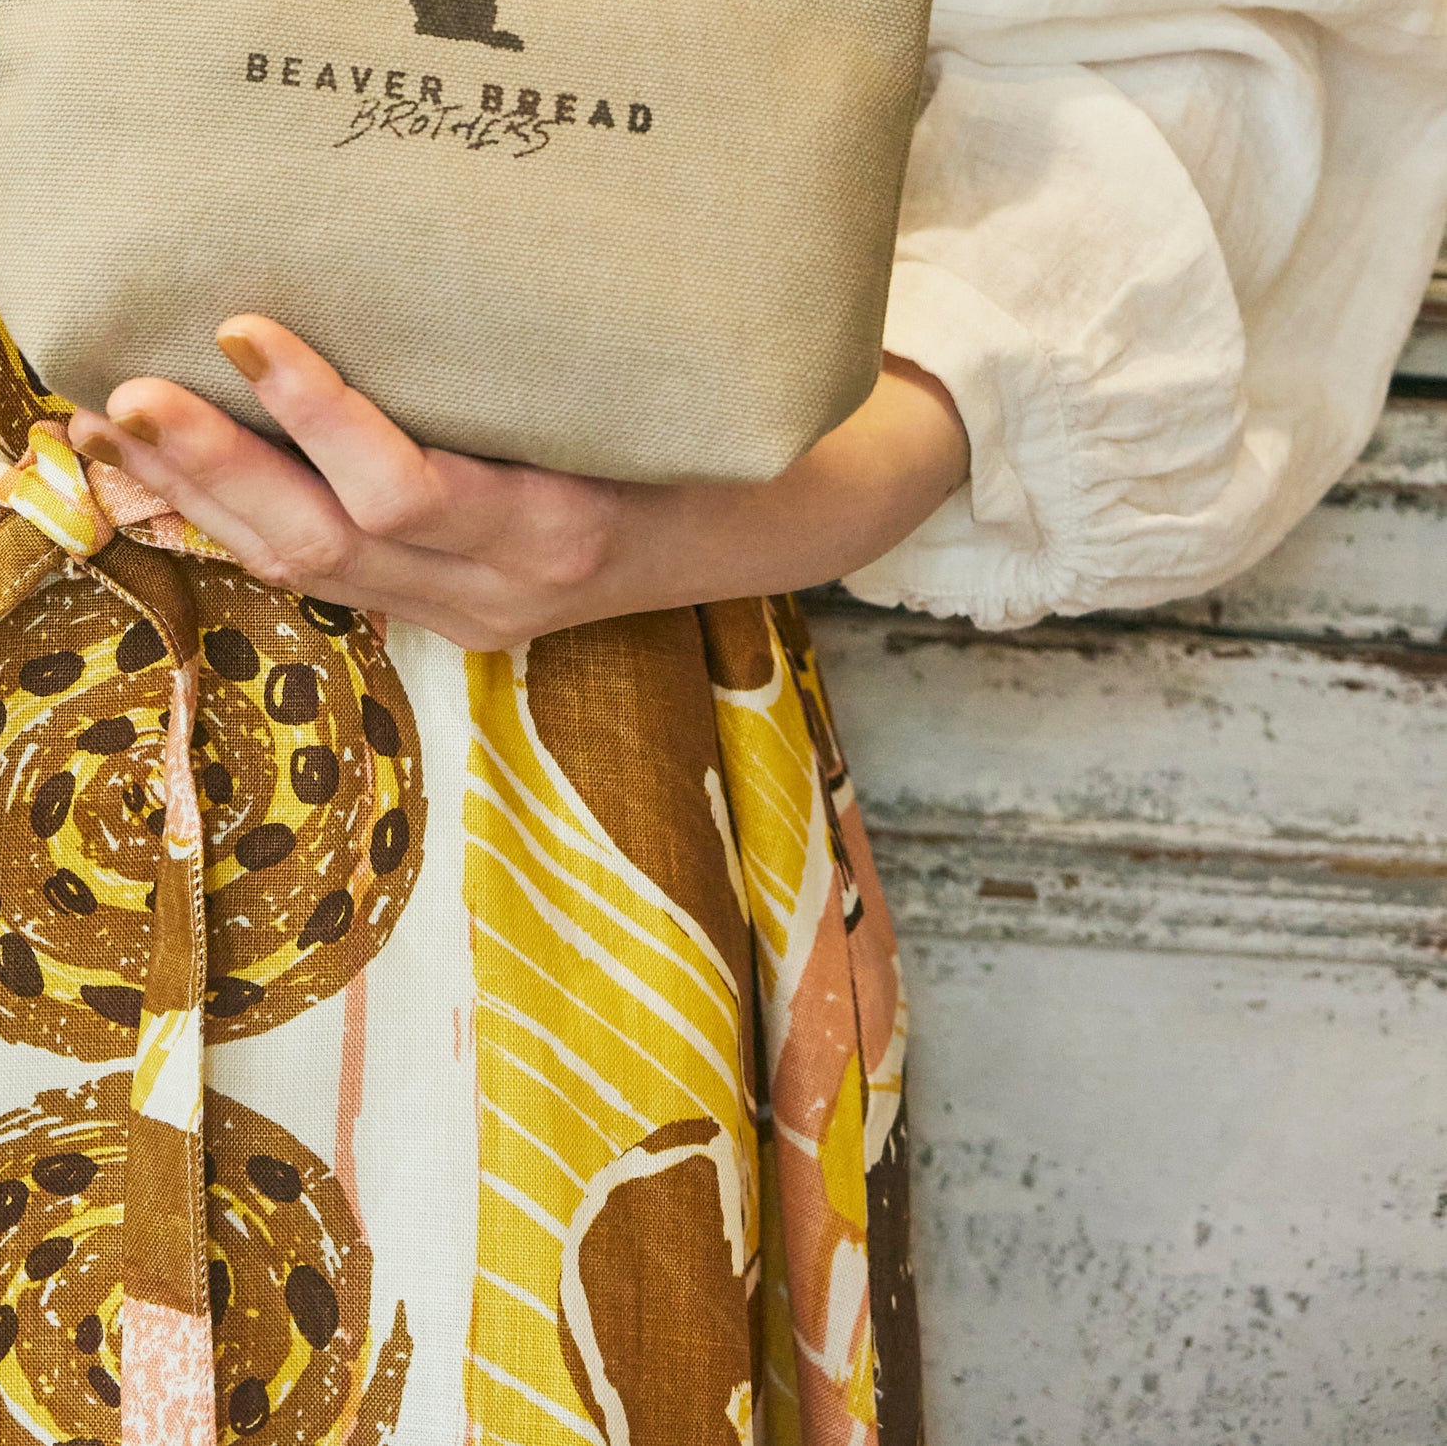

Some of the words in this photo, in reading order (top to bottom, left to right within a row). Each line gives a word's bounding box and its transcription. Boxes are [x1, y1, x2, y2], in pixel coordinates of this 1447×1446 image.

[246, 53, 443, 105] BEAVER
[481, 84, 652, 134] BREAD
[333, 100, 556, 158] BROTHERS
